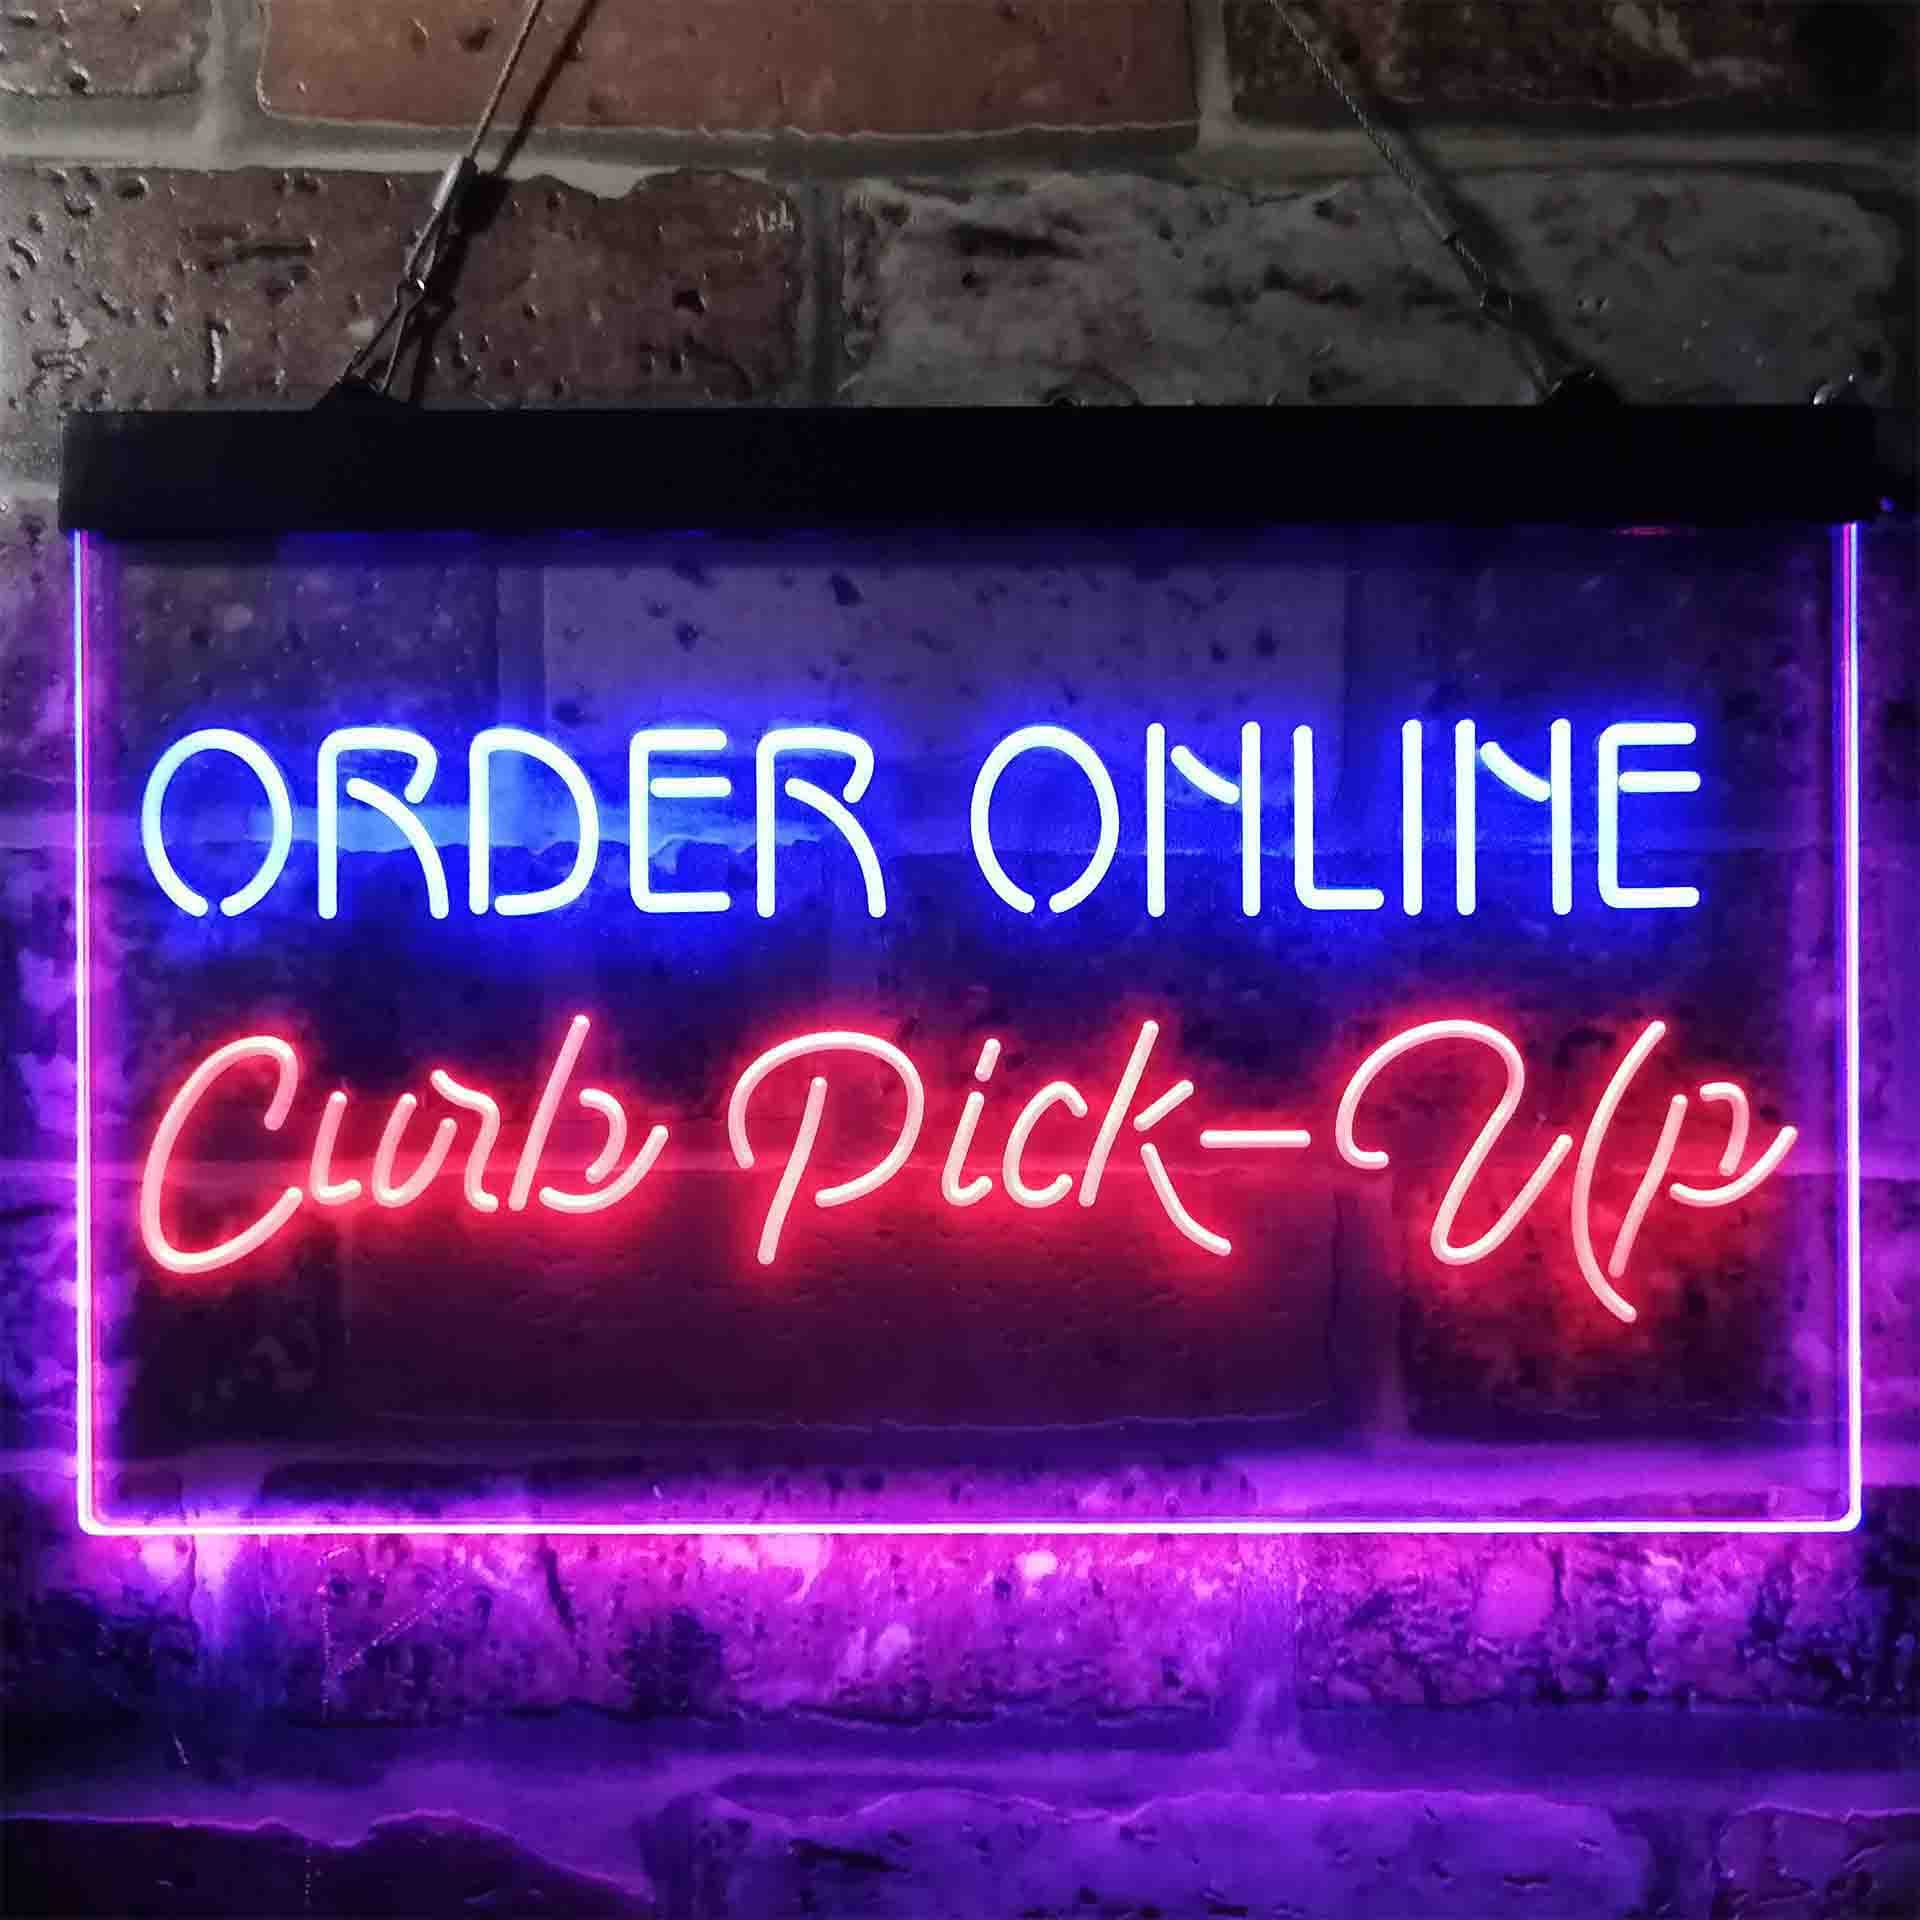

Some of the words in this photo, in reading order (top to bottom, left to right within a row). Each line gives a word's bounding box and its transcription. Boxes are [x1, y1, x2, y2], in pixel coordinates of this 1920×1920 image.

[141, 723, 887, 919] ORDER
[970, 718, 1701, 916] ONLINE
[138, 1014, 670, 1276] Curb
[727, 1018, 1799, 1324] Pick-Up
